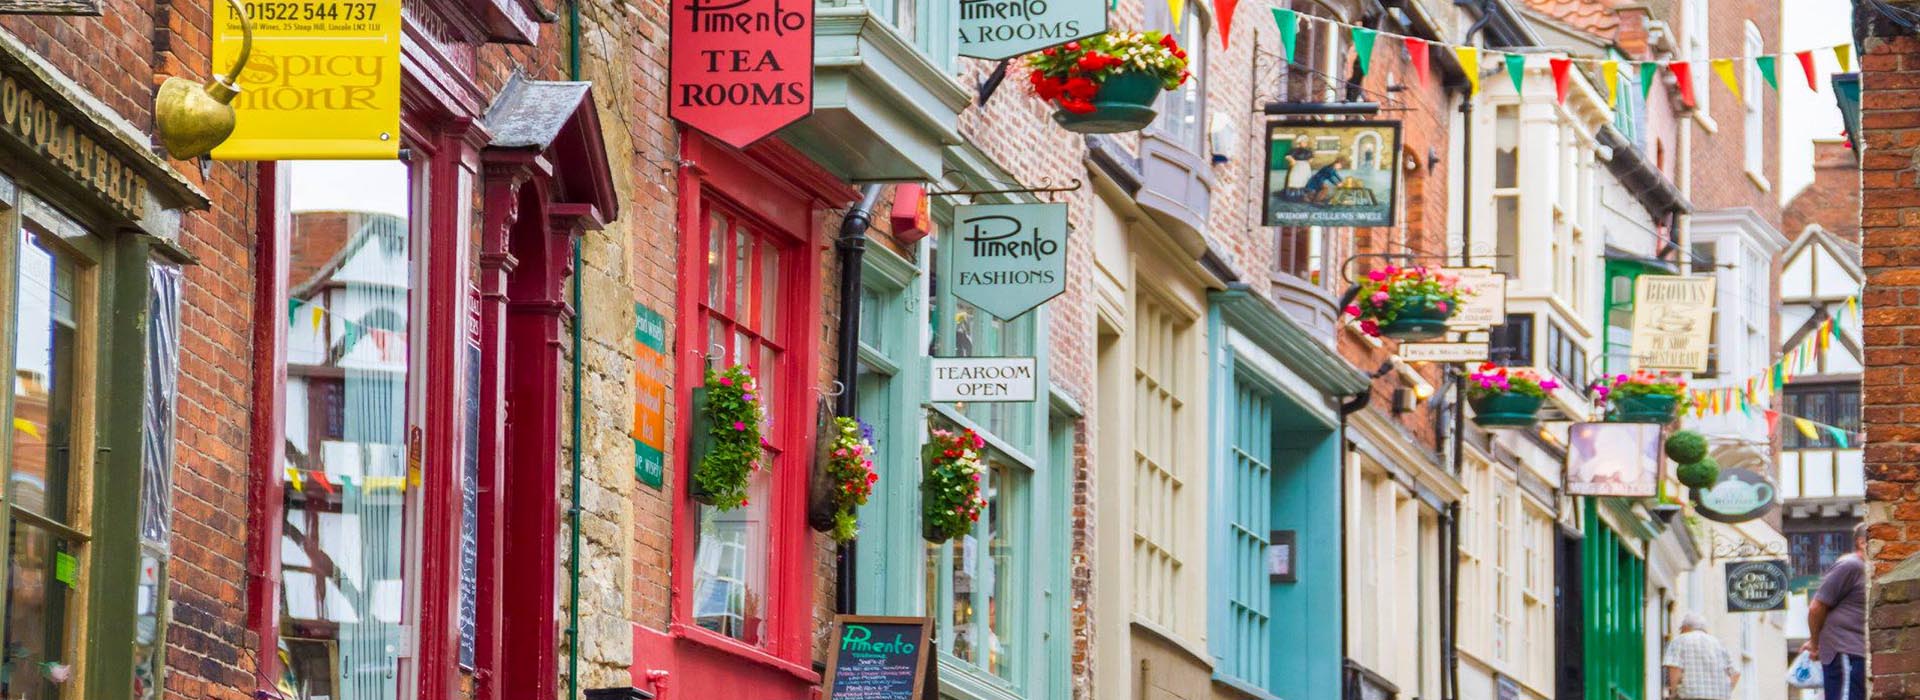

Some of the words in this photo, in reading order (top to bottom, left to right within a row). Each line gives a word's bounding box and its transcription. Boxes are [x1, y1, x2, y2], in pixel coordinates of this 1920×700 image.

[245, 3, 298, 20] 01522
[303, 3, 338, 20] 544
[344, 3, 377, 20] 737
[684, 0, 805, 36] Pimento
[978, 20, 1080, 43] ROOMS
[701, 50, 784, 72] TEA
[679, 82, 805, 107] ROOMS
[0, 76, 147, 221] OCOLATERIE
[963, 215, 1058, 261] Pimento
[960, 270, 1055, 285] FASHIONS
[1646, 282, 1707, 302] BROWNS
[936, 366, 1031, 380] TEAROOM
[957, 383, 1008, 396] OPEN
[843, 625, 915, 654] Pimento
